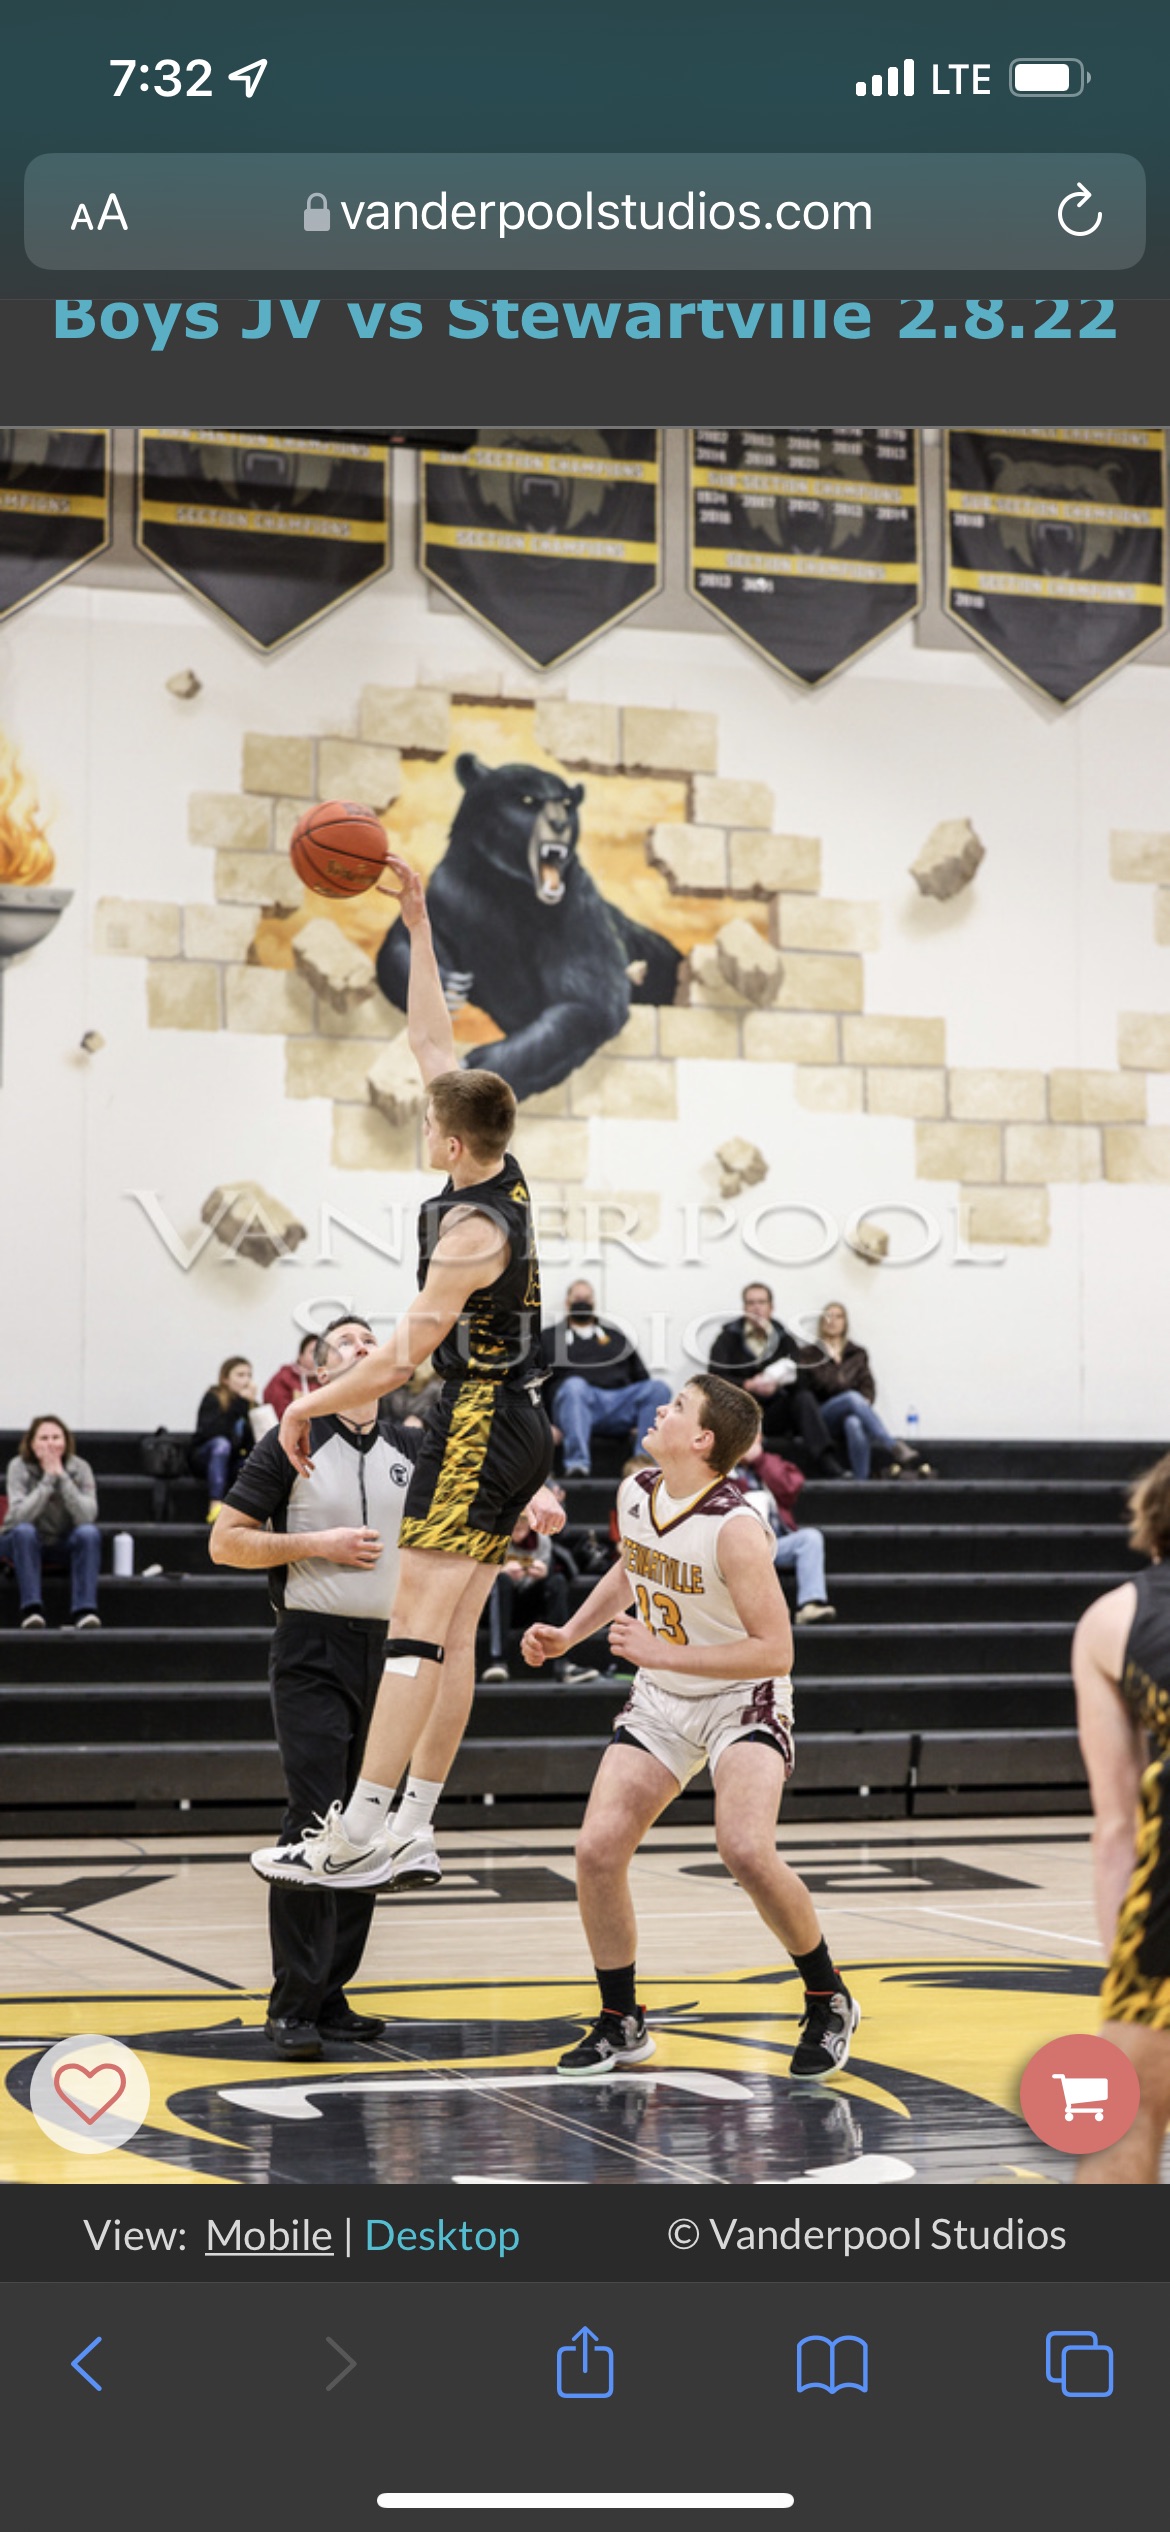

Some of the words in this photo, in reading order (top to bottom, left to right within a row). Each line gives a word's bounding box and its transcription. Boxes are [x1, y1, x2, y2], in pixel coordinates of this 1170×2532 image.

[110, 59, 213, 98] 7:32
[932, 63, 991, 95] LTE
[340, 190, 872, 239] vanderpoolstudios.com
[55, 299, 219, 352] Boys
[241, 299, 321, 339] JV
[346, 302, 423, 340] vs
[448, 299, 871, 340] Stewartville
[900, 299, 1117, 340] 2.8.22
[254, 514, 350, 535] CHAMPIONS
[531, 537, 625, 558] CHAMPIONS
[635, 1583, 689, 1646] 13
[82, 2218, 186, 2252] View:
[204, 2218, 335, 2257] Mobile
[366, 2218, 520, 2258] Desktop
[667, 2217, 700, 2251] ©
[708, 2217, 920, 2257] Vanderpool
[930, 2217, 1067, 2251] Studios
